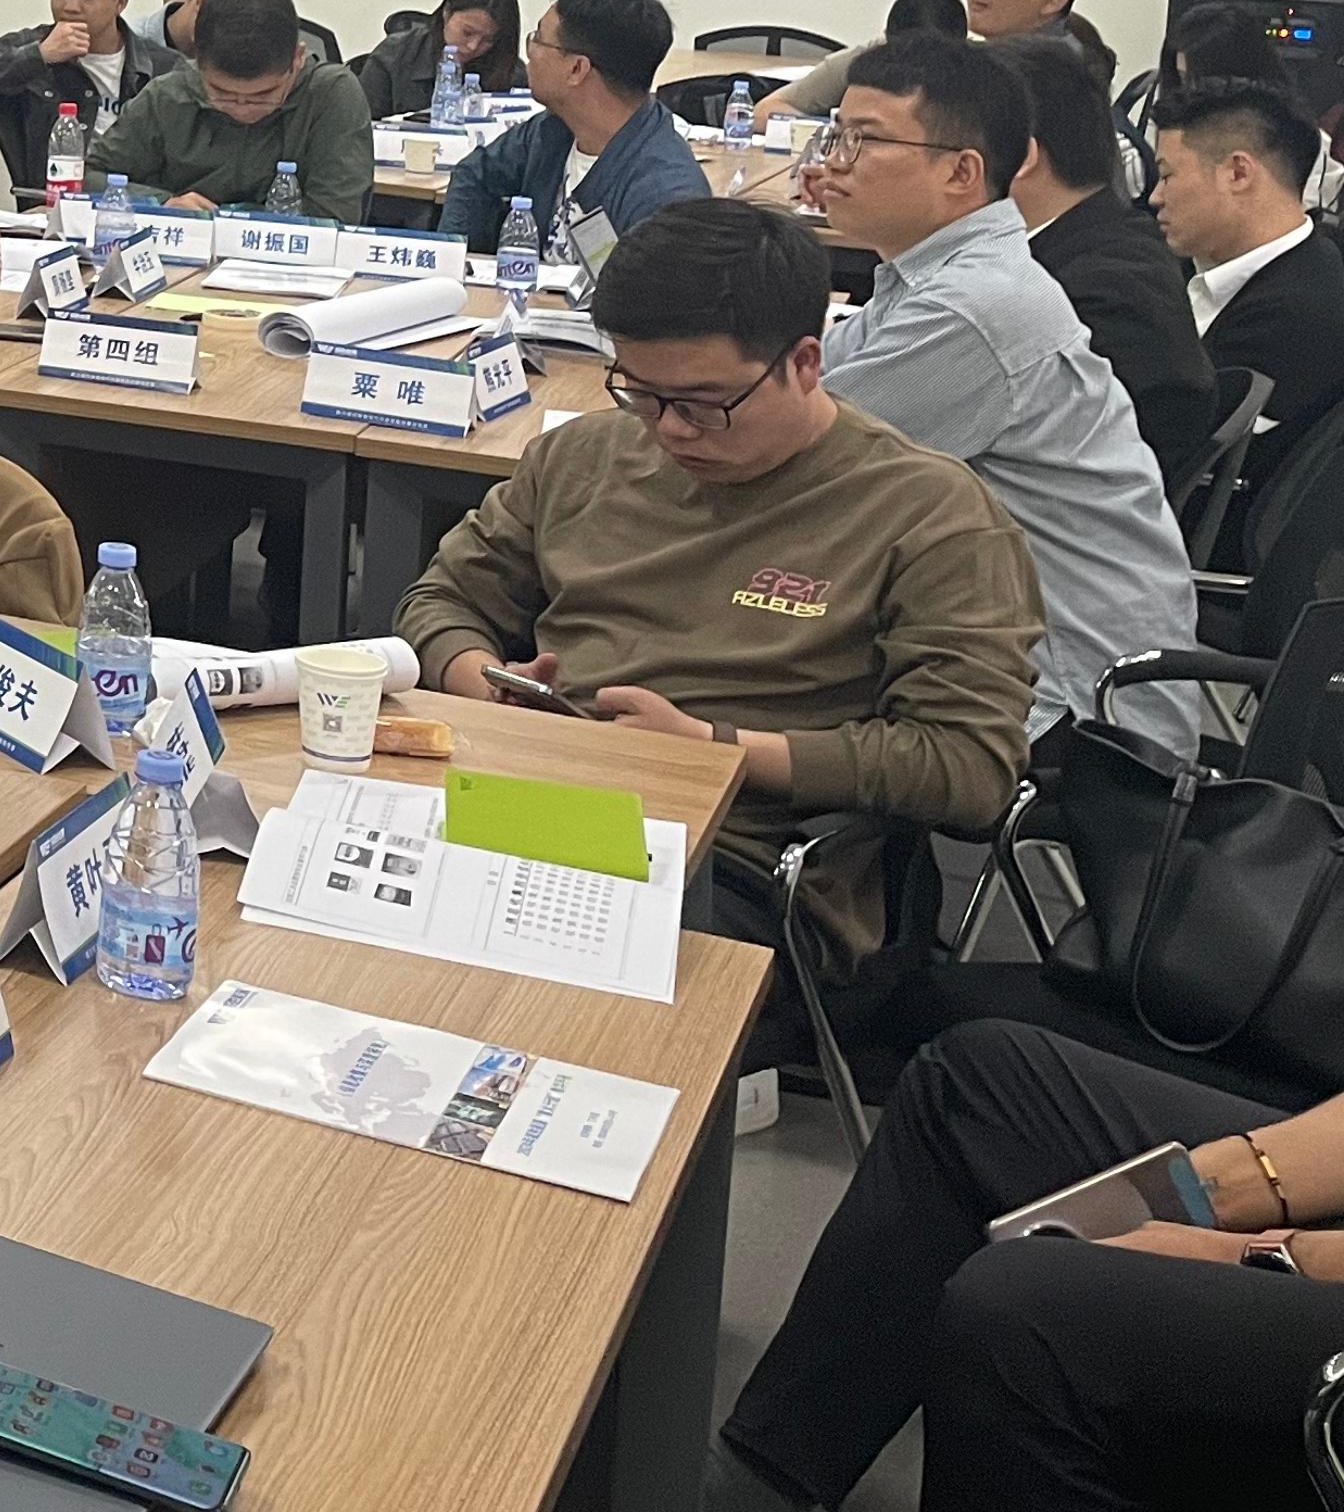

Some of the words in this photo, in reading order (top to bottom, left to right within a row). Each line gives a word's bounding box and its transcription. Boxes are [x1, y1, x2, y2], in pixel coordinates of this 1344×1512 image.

[241, 229, 309, 255] 谢振国
[77, 333, 160, 366] 第四组
